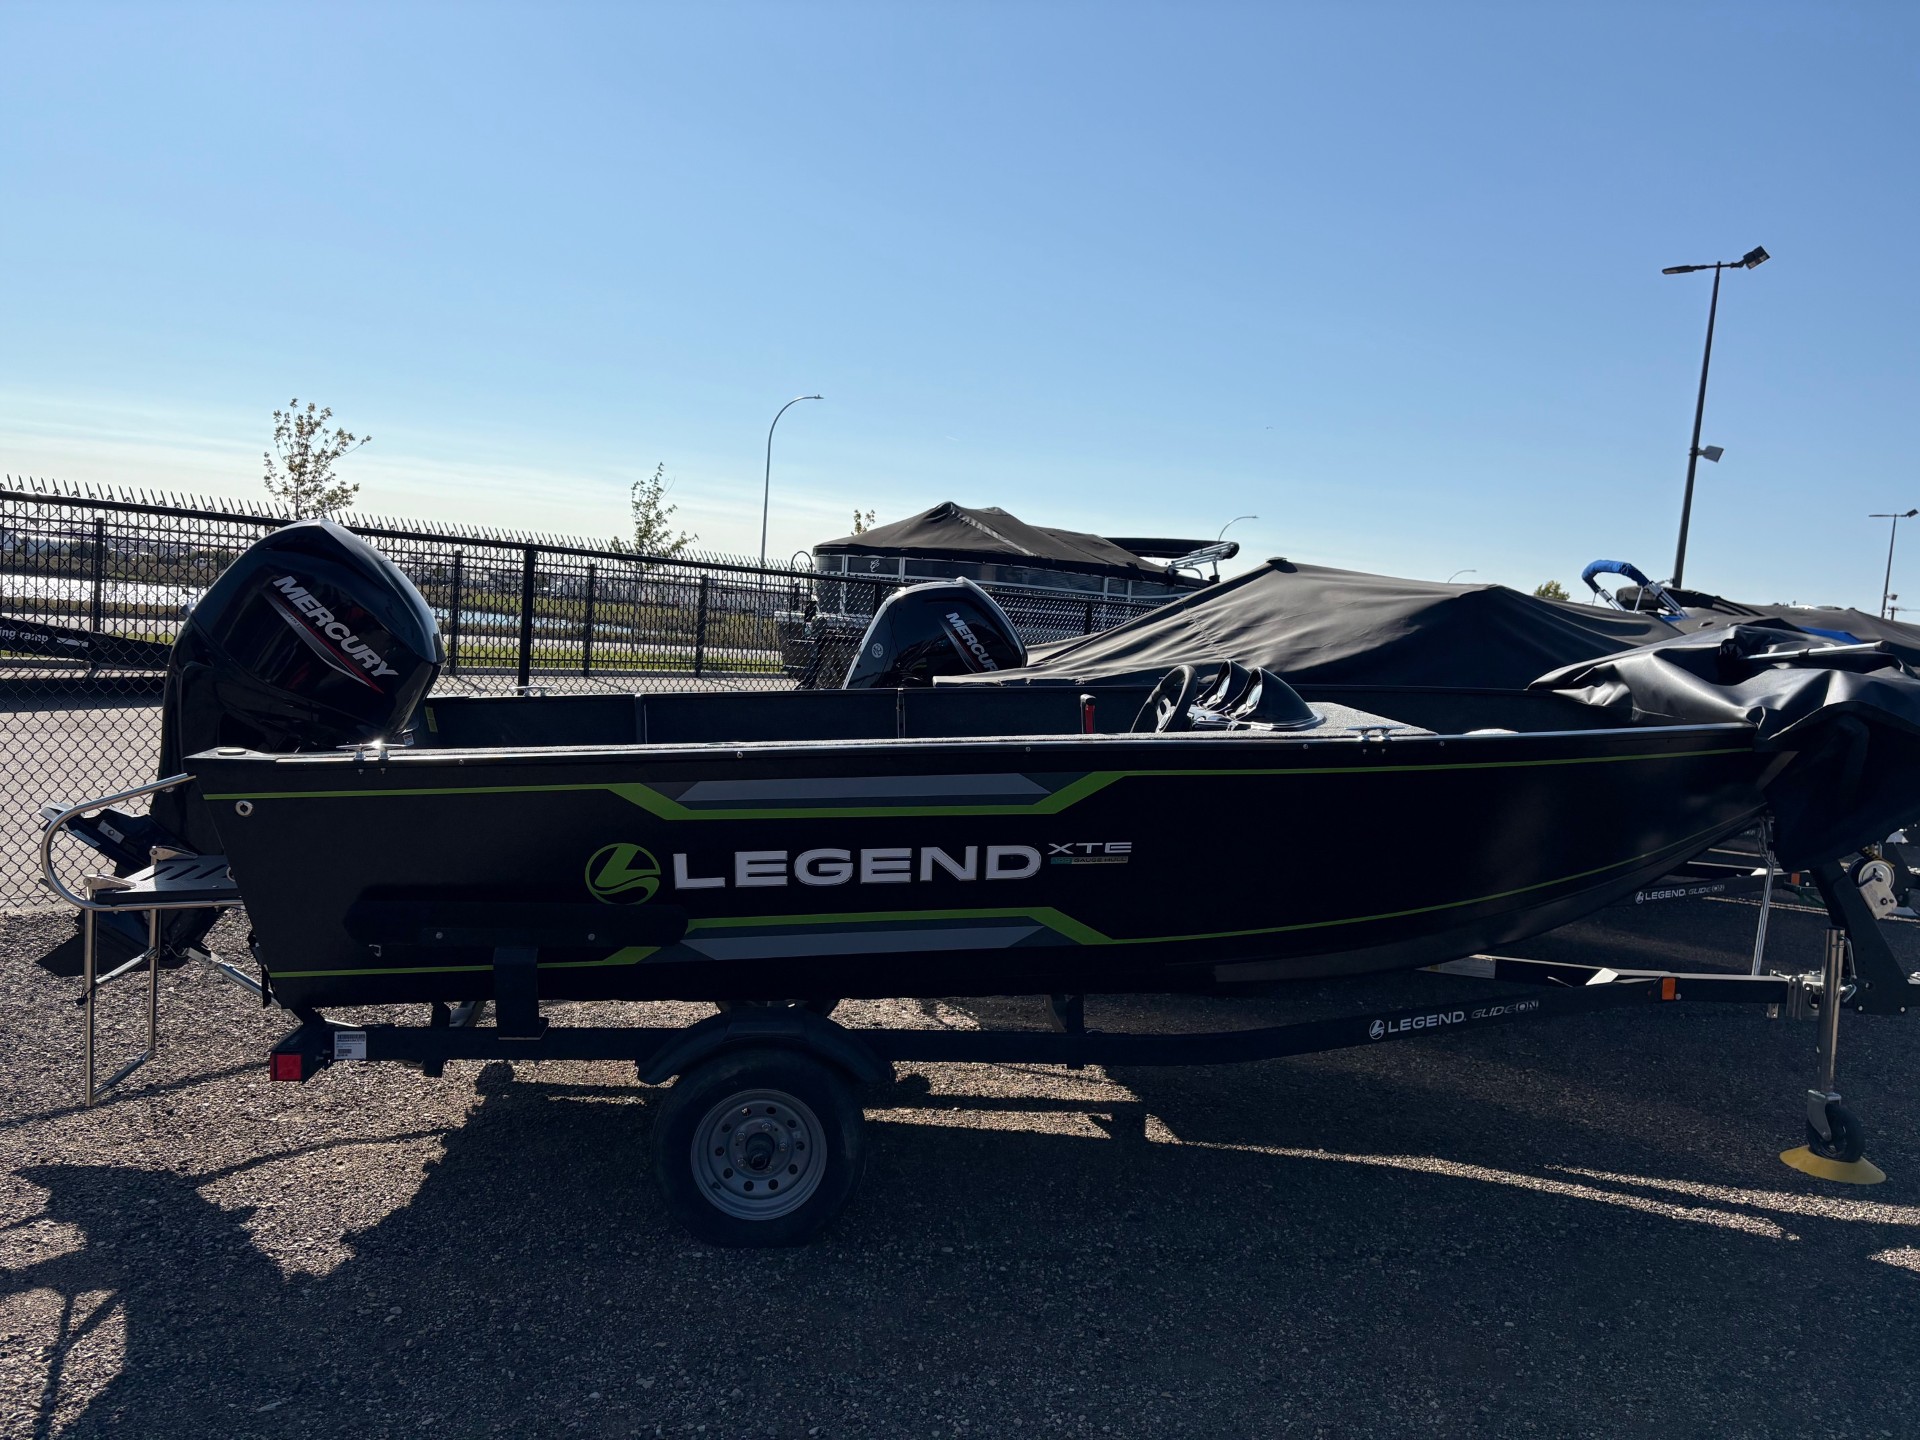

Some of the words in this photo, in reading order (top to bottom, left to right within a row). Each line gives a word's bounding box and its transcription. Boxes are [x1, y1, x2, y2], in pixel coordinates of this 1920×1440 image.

[272, 575, 400, 678] MERCURY
[19, 631, 49, 645] ramp
[1047, 841, 1133, 855] XTE
[672, 844, 1042, 891] LEGEND
[1645, 888, 1686, 901] LEGEND
[1387, 1011, 1465, 1034] LEGEND
